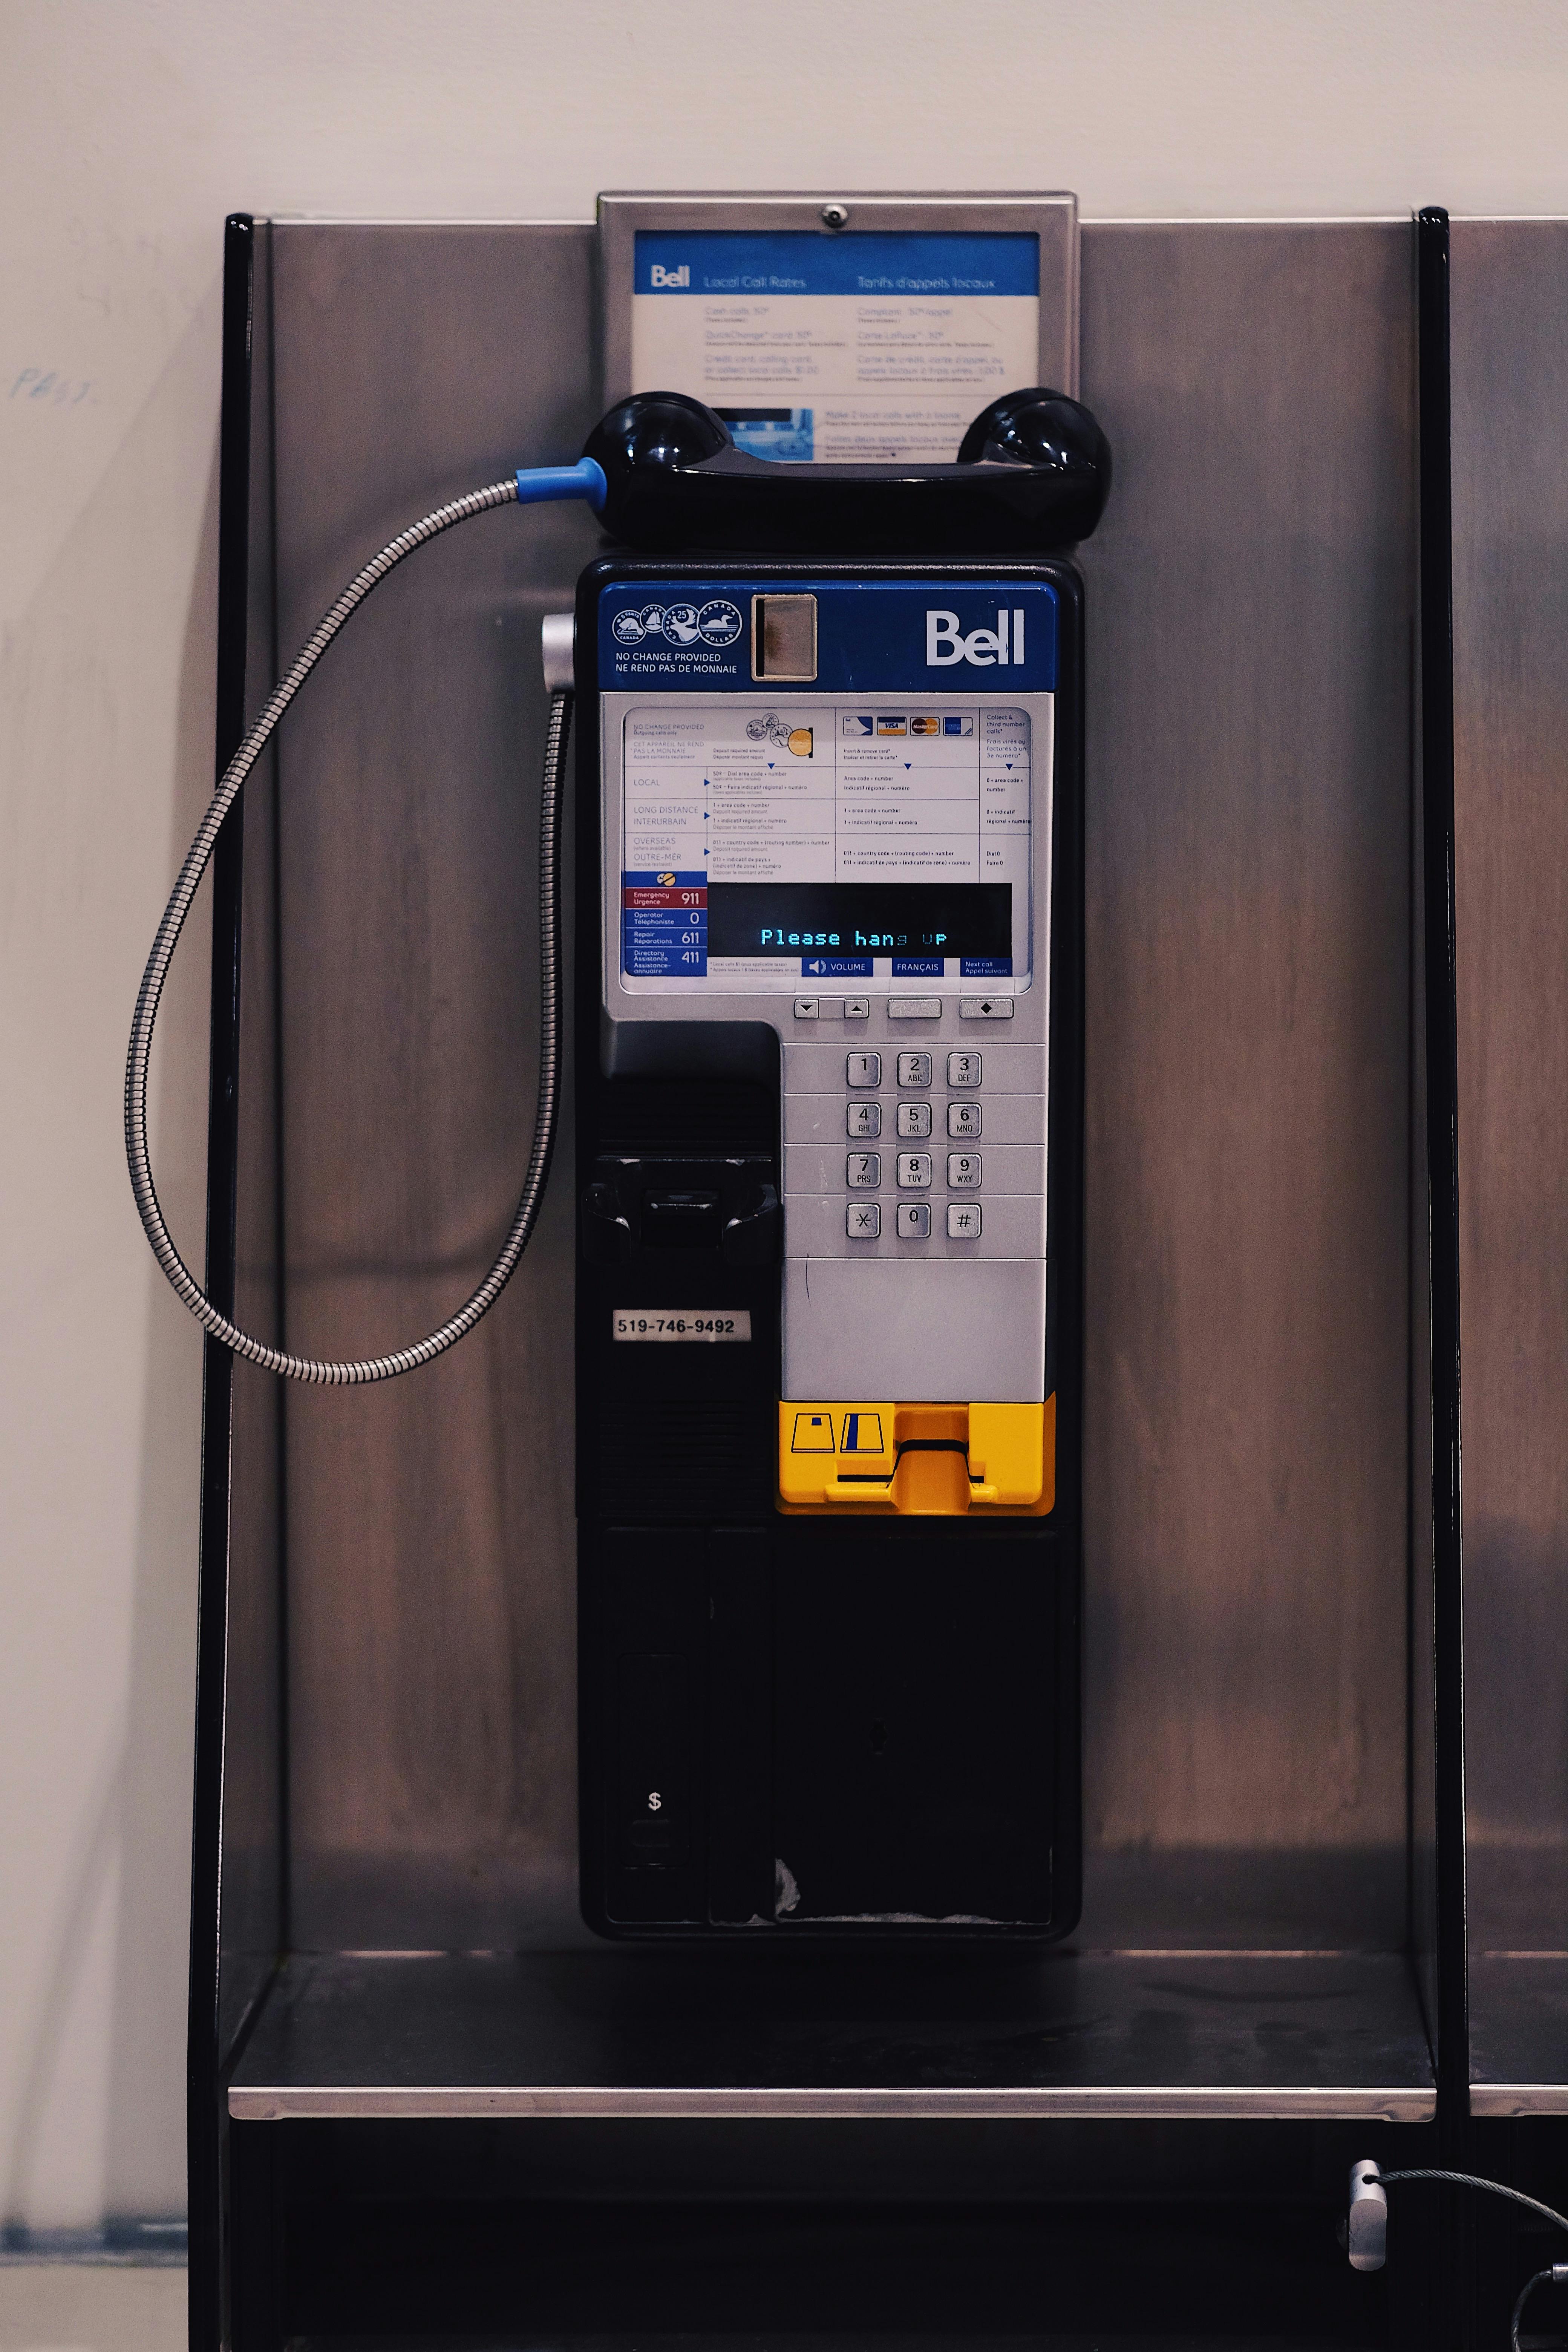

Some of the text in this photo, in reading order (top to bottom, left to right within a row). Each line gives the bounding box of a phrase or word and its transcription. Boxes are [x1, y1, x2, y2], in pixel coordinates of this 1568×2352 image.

[651, 265, 689, 287] Bell
[704, 275, 807, 288] Local Call Rates
[858, 276, 995, 289] Tarifs d'appels locaux
[703, 604, 735, 616] CANADA
[666, 611, 677, 639] CANADA
[706, 633, 733, 642] DOLLAR
[926, 609, 1024, 666] Bell
[682, 893, 698, 904] 911
[690, 913, 699, 924] 0
[682, 932, 698, 943] 611
[762, 929, 839, 945] Please
[856, 931, 906, 946] hang
[682, 952, 698, 963] 411
[897, 964, 938, 972] FRANÇAIS
[862, 1058, 867, 1070] 1
[911, 1058, 919, 1070] 2
[960, 1058, 969, 1072] 3
[859, 1109, 869, 1121] 4
[910, 1109, 918, 1121] 5
[960, 1109, 969, 1121] 6
[860, 1159, 868, 1171] 7
[910, 1159, 919, 1171] 8
[960, 1159, 969, 1171] 9
[910, 1210, 918, 1222] 0
[957, 1214, 971, 1227] #
[619, 1320, 734, 1333] 519-746-9492
[649, 1792, 661, 1810] $
